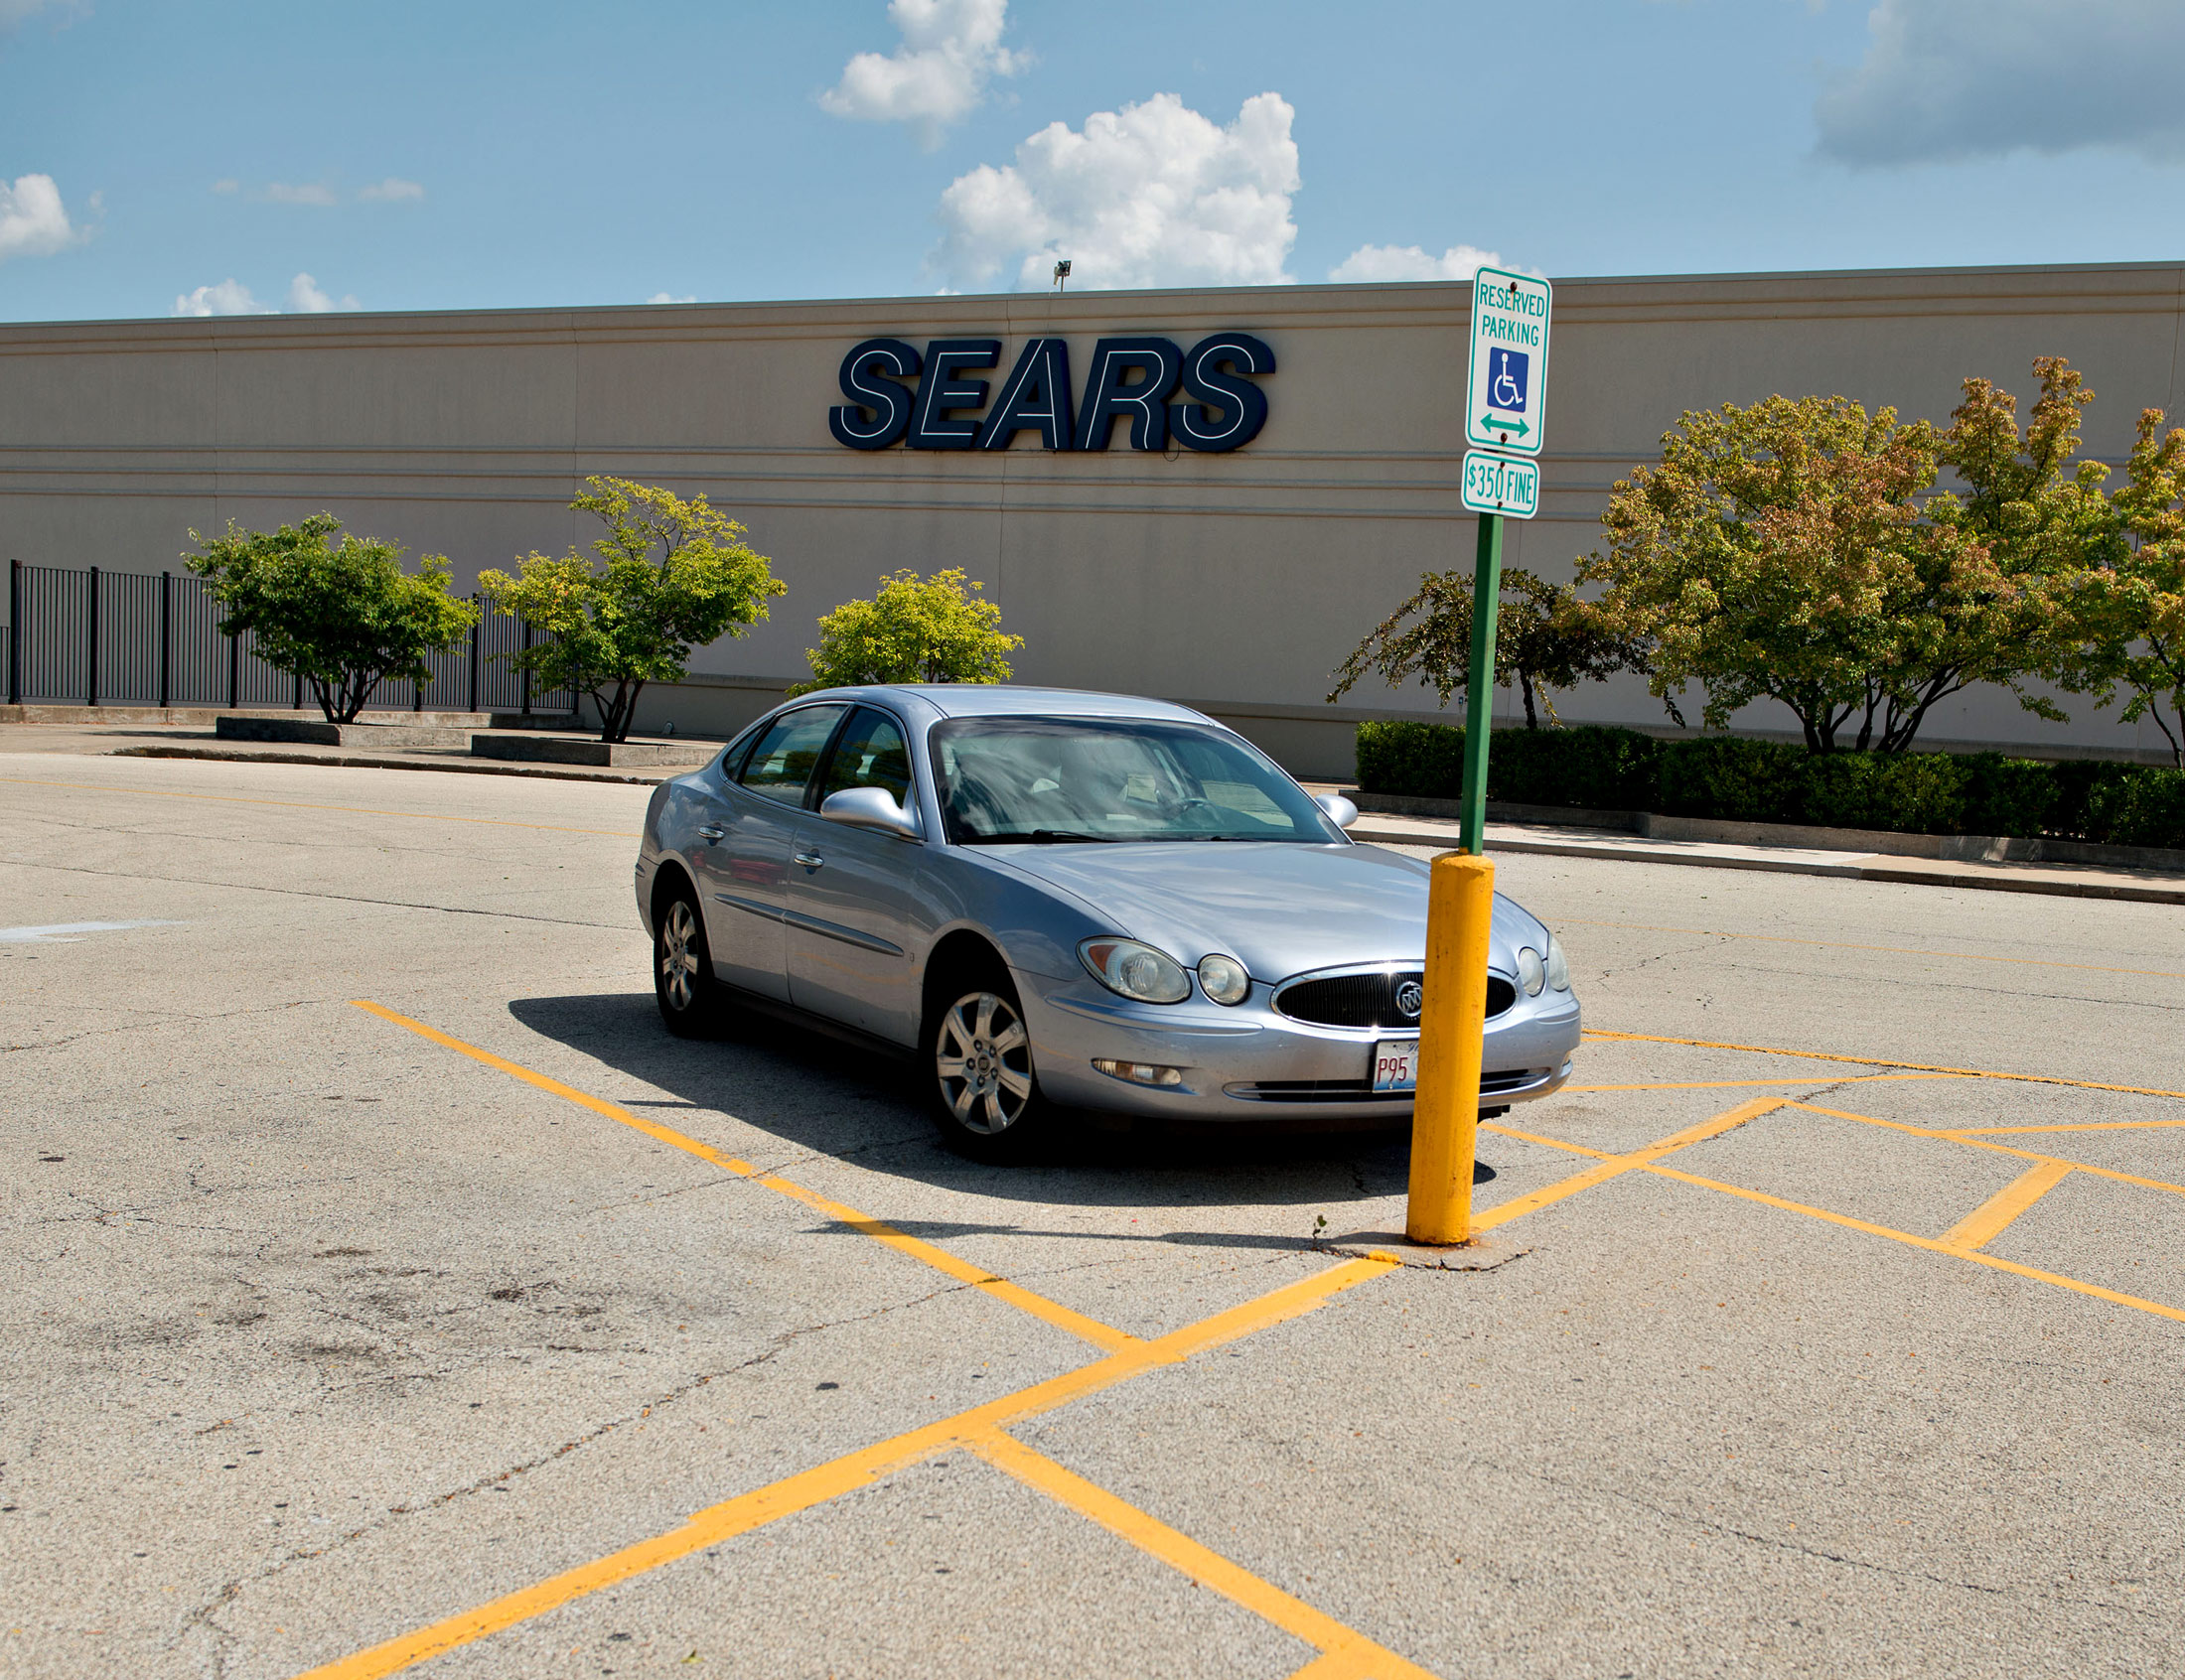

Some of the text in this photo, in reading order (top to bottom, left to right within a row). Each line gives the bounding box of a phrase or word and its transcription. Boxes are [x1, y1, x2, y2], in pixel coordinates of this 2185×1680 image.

[1480, 283, 1545, 318] RESERVED
[1482, 314, 1539, 347] PARKING
[828, 333, 1276, 452] SEARS
[1468, 464, 1533, 504] $350 FINE
[1378, 1056, 1408, 1083] P95
